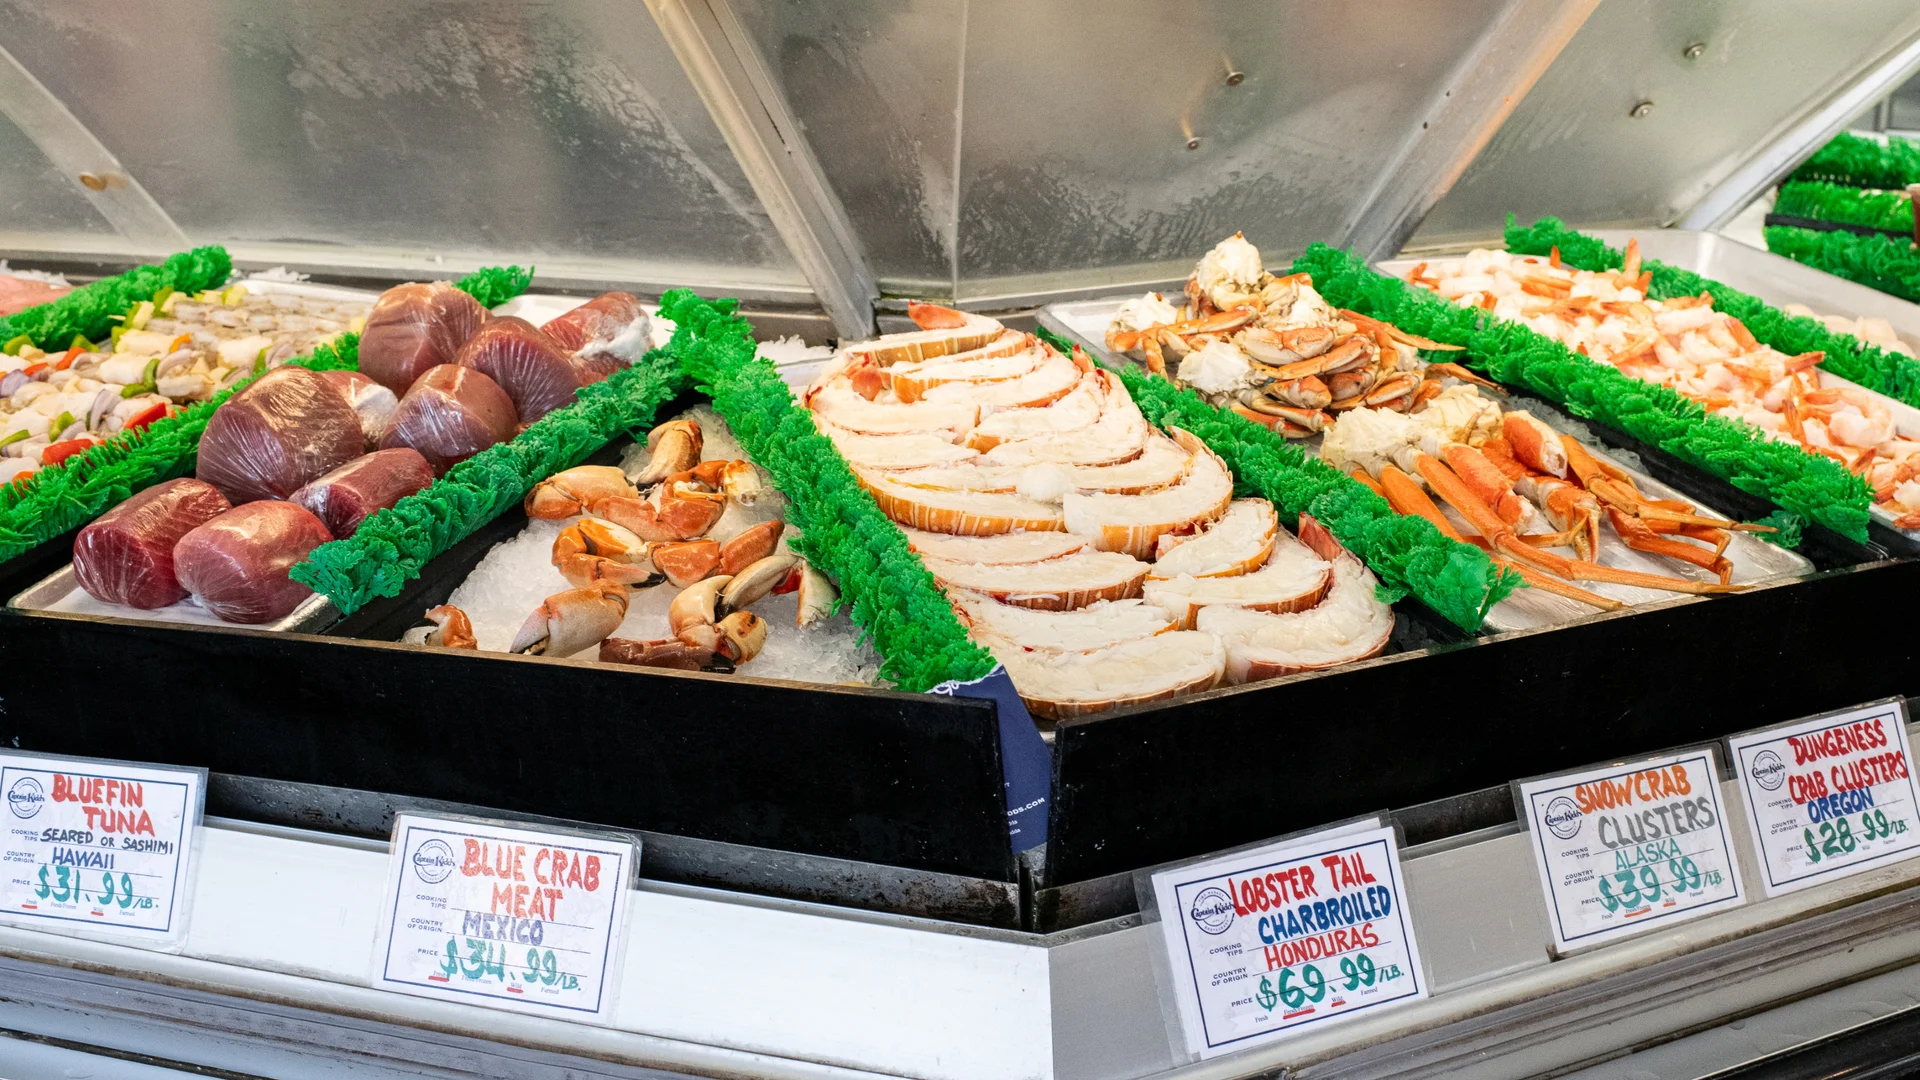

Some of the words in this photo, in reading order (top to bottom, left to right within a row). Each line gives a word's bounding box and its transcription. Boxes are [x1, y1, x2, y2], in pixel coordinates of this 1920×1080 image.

[1787, 719, 1887, 766] DUNGENESS
[1788, 771, 1828, 805] CRAB
[1831, 750, 1908, 792] CLUSTERS
[51, 774, 143, 808] BLUEFIN
[1768, 798, 1792, 808] COOKING
[1808, 786, 1875, 823] OREGON
[82, 806, 155, 837] TUNA
[1598, 796, 1716, 849] CLUSTERS
[1772, 819, 1797, 829] COUNTRY
[11, 828, 38, 836] COOKING
[1779, 824, 1798, 833] ORIGIN
[40, 828, 93, 844] SEARED
[100, 836, 115, 848] OR
[121, 837, 173, 854] SASHIMI
[6, 850, 35, 858] COUNTRY
[52, 847, 114, 869] HAWAII
[1561, 847, 1589, 858] COOKING
[1616, 837, 1682, 871] ALASKA
[13, 856, 34, 864] ORIGIN
[460, 838, 526, 882] BLUE
[534, 848, 601, 892] CRAB
[1565, 869, 1593, 880] COUNTRY
[1574, 875, 1595, 885] ORIGIN
[12, 878, 30, 886] PRICE
[1228, 865, 1318, 917] LOBSTER
[1321, 852, 1376, 893] TAIL
[416, 894, 448, 904] COOKING
[491, 883, 563, 921] MEAT
[1581, 897, 1600, 906] PRICE
[430, 902, 446, 910] TIPS
[1258, 885, 1391, 944] CHARBROILED
[411, 918, 443, 926] COUNTRY
[462, 910, 544, 946] MEXICO
[418, 924, 442, 933] ORIGIN
[418, 948, 438, 956] PRICE
[1209, 943, 1242, 955] COOKING
[1264, 922, 1379, 971] HONDURAS
[1227, 949, 1243, 957] TIPS
[1213, 967, 1247, 979] COUNTRY
[1211, 978, 1222, 986] OF
[1222, 973, 1248, 985] ORIGIN
[1231, 998, 1253, 1008] PRICE
[1254, 1014, 1269, 1024] Fresh
[1331, 995, 1344, 1003] Wild
[1360, 986, 1378, 996] Farmed
